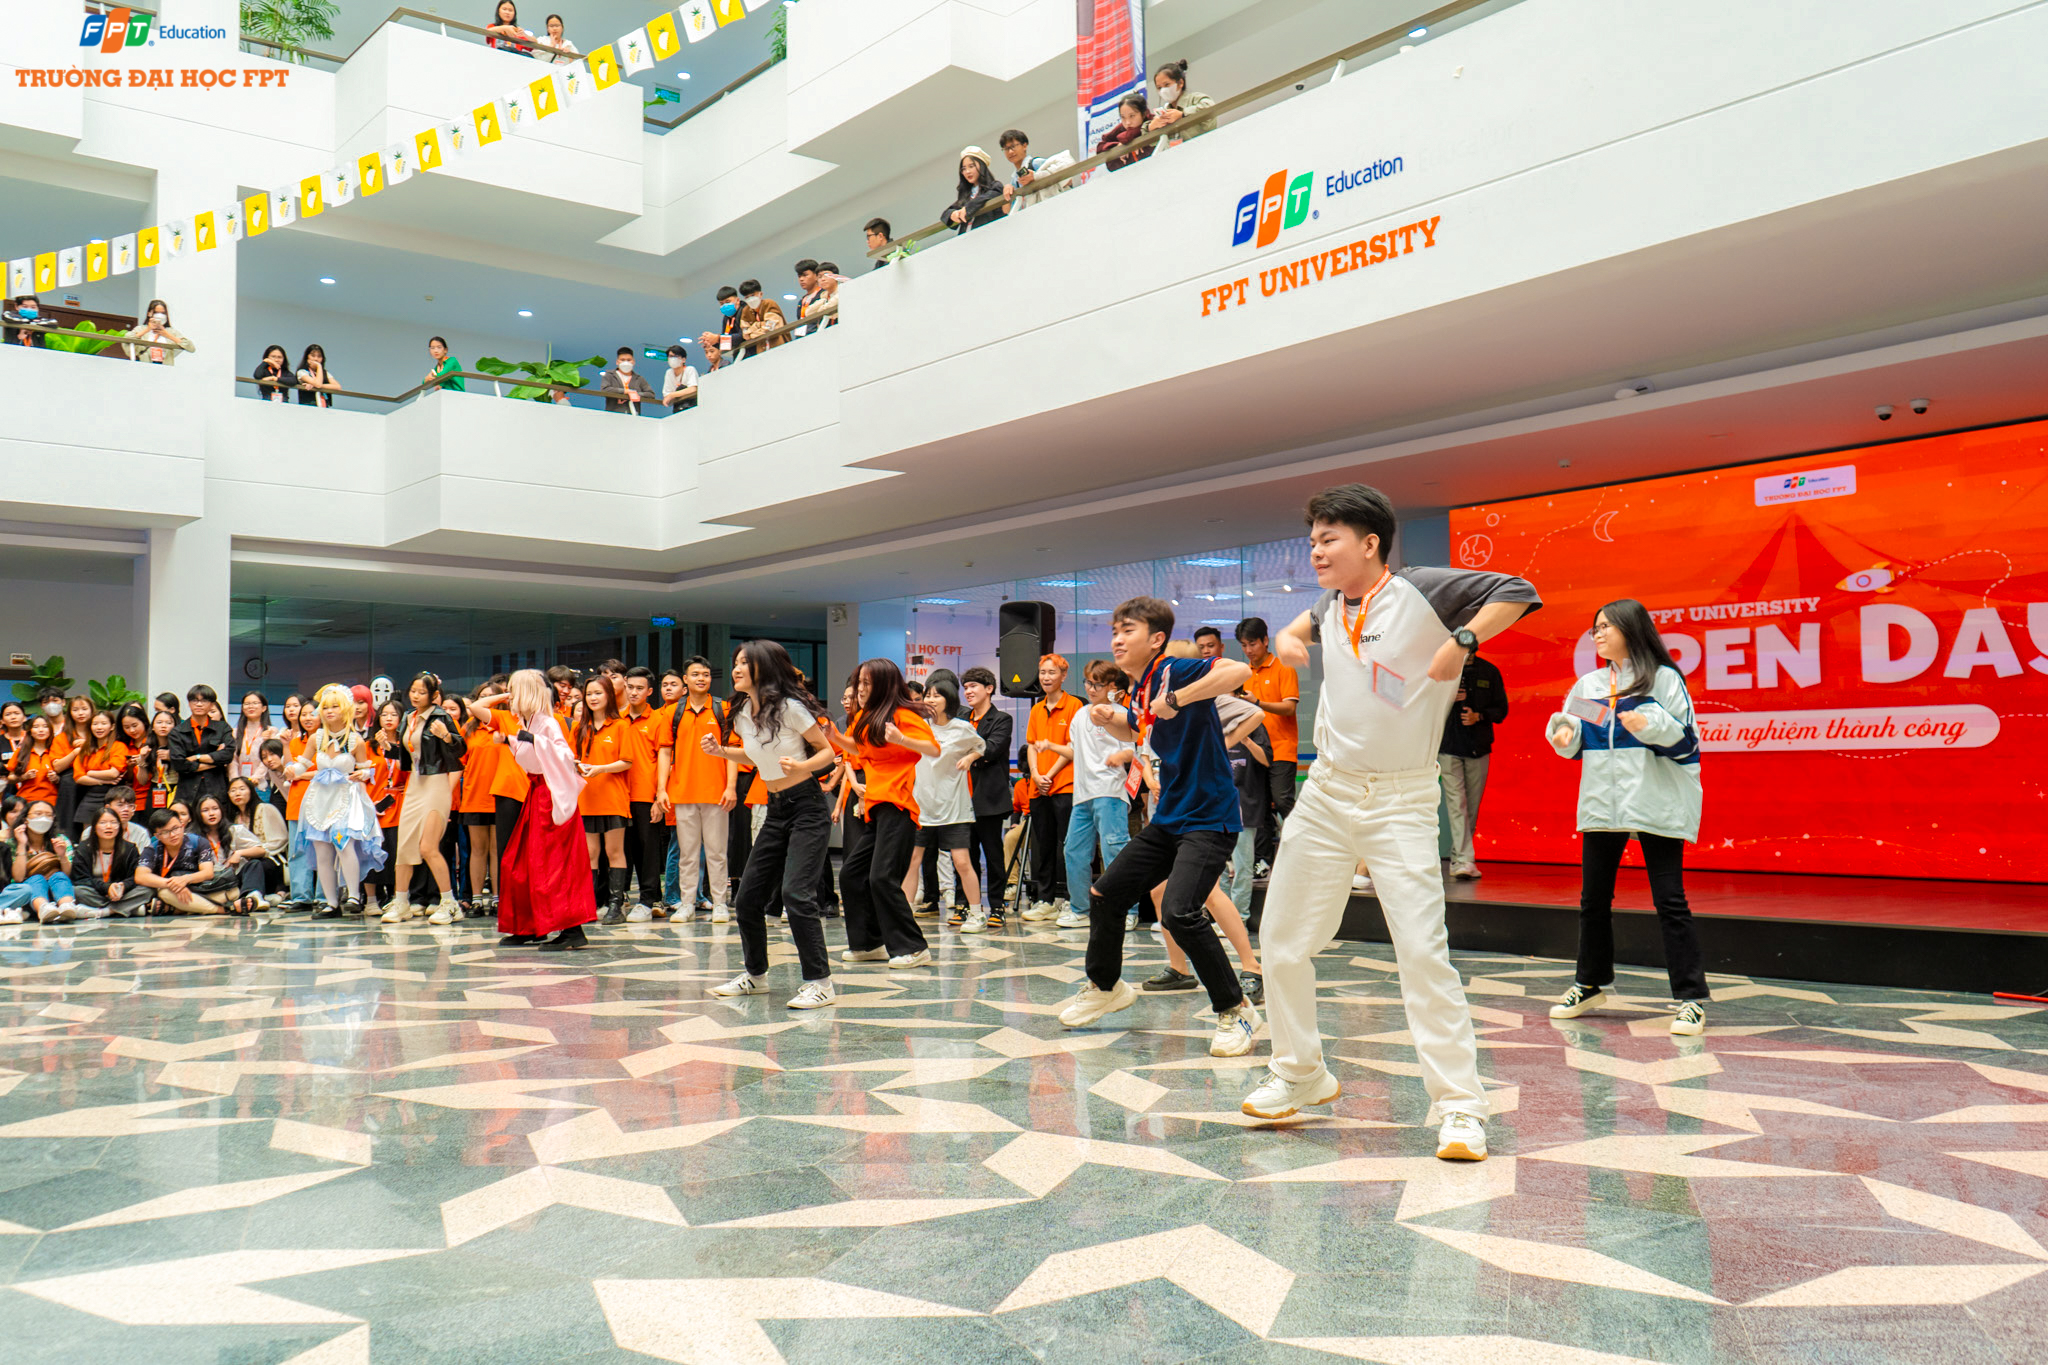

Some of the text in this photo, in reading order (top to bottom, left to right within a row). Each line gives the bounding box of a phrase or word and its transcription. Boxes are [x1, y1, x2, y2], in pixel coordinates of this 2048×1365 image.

[1234, 155, 1404, 236] FPT Education
[1200, 214, 1442, 318] FPT UNIVERSITY
[1650, 596, 1821, 625] FPT UNIVERSITY
[943, 645, 963, 656] FPT
[1736, 718, 1821, 749] nghiệm
[1825, 714, 1899, 739] thành
[1904, 717, 1968, 745] công
